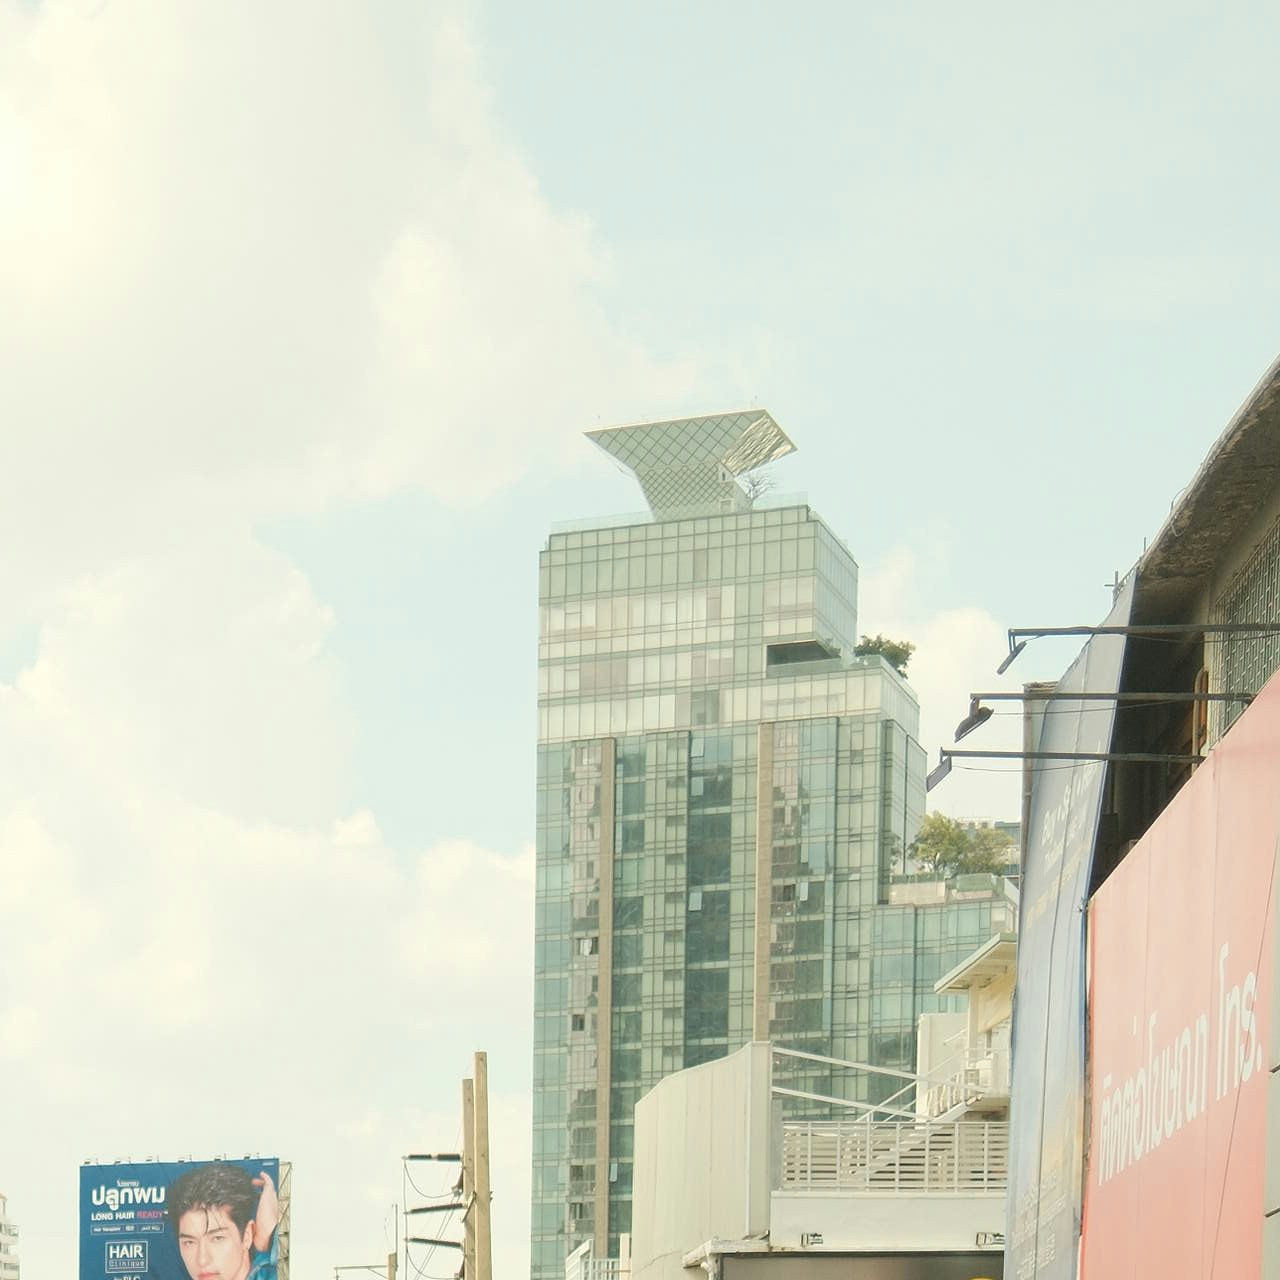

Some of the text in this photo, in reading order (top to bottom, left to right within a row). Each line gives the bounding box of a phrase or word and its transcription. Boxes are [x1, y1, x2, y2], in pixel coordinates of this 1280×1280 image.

[1097, 943, 1263, 1187] ติดต่อโฆษณา โทร.
[91, 1212, 113, 1221] LONG
[115, 1212, 135, 1220] HAIR
[109, 1245, 144, 1258] HAIR
[109, 1259, 145, 1269] Clinique
